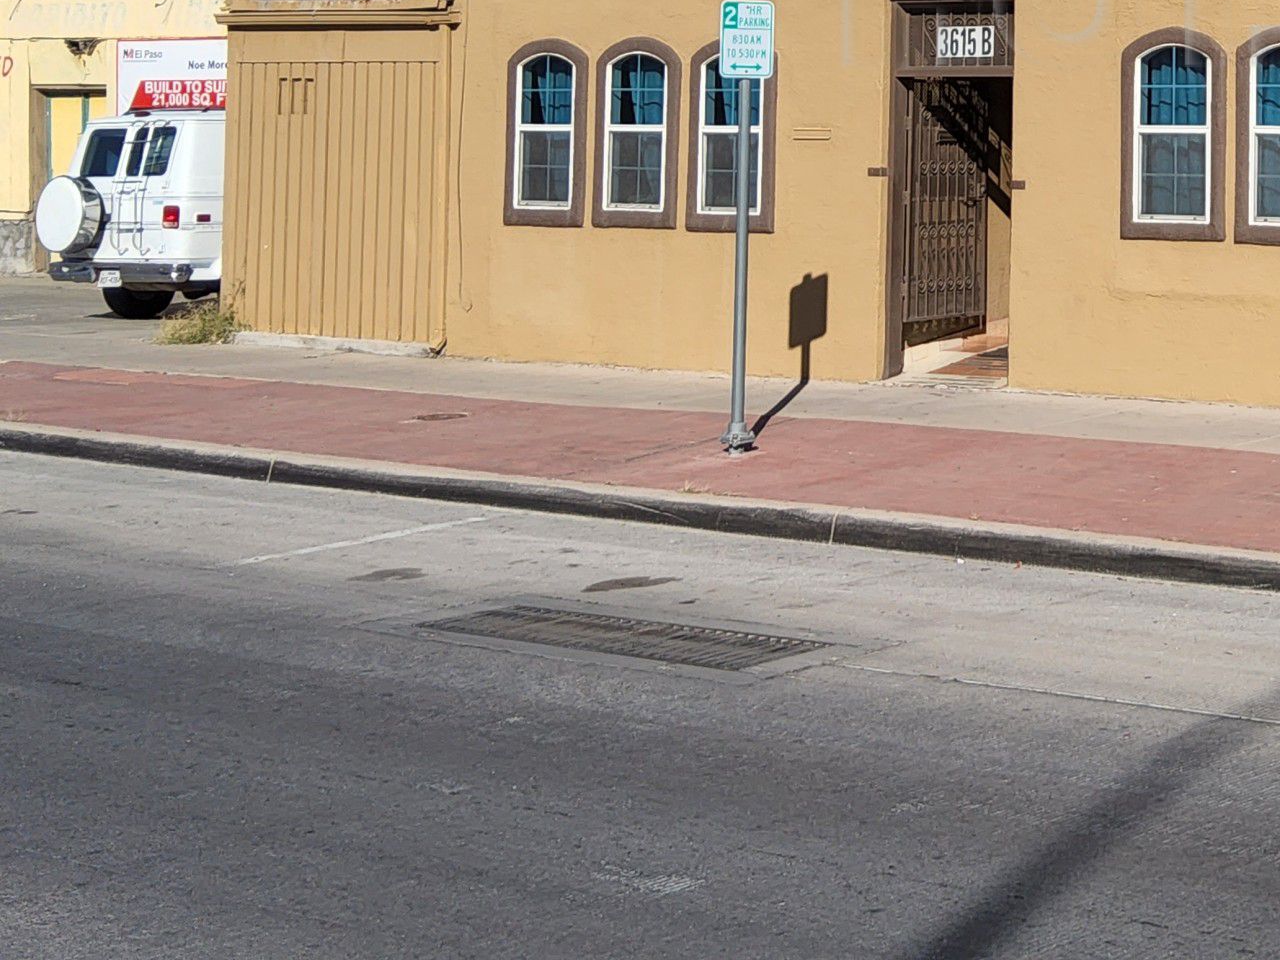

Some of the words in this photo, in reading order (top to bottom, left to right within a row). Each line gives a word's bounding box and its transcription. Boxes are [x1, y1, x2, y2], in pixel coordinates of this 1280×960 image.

[724, 6, 737, 25] 2
[739, 17, 770, 27] PARKING
[940, 28, 977, 56] 3615
[981, 27, 992, 55] B
[144, 50, 163, 59] Paso
[188, 60, 205, 70] Noe
[144, 81, 182, 94] BUILD
[184, 81, 202, 94] TO
[152, 93, 190, 107] 21,000
